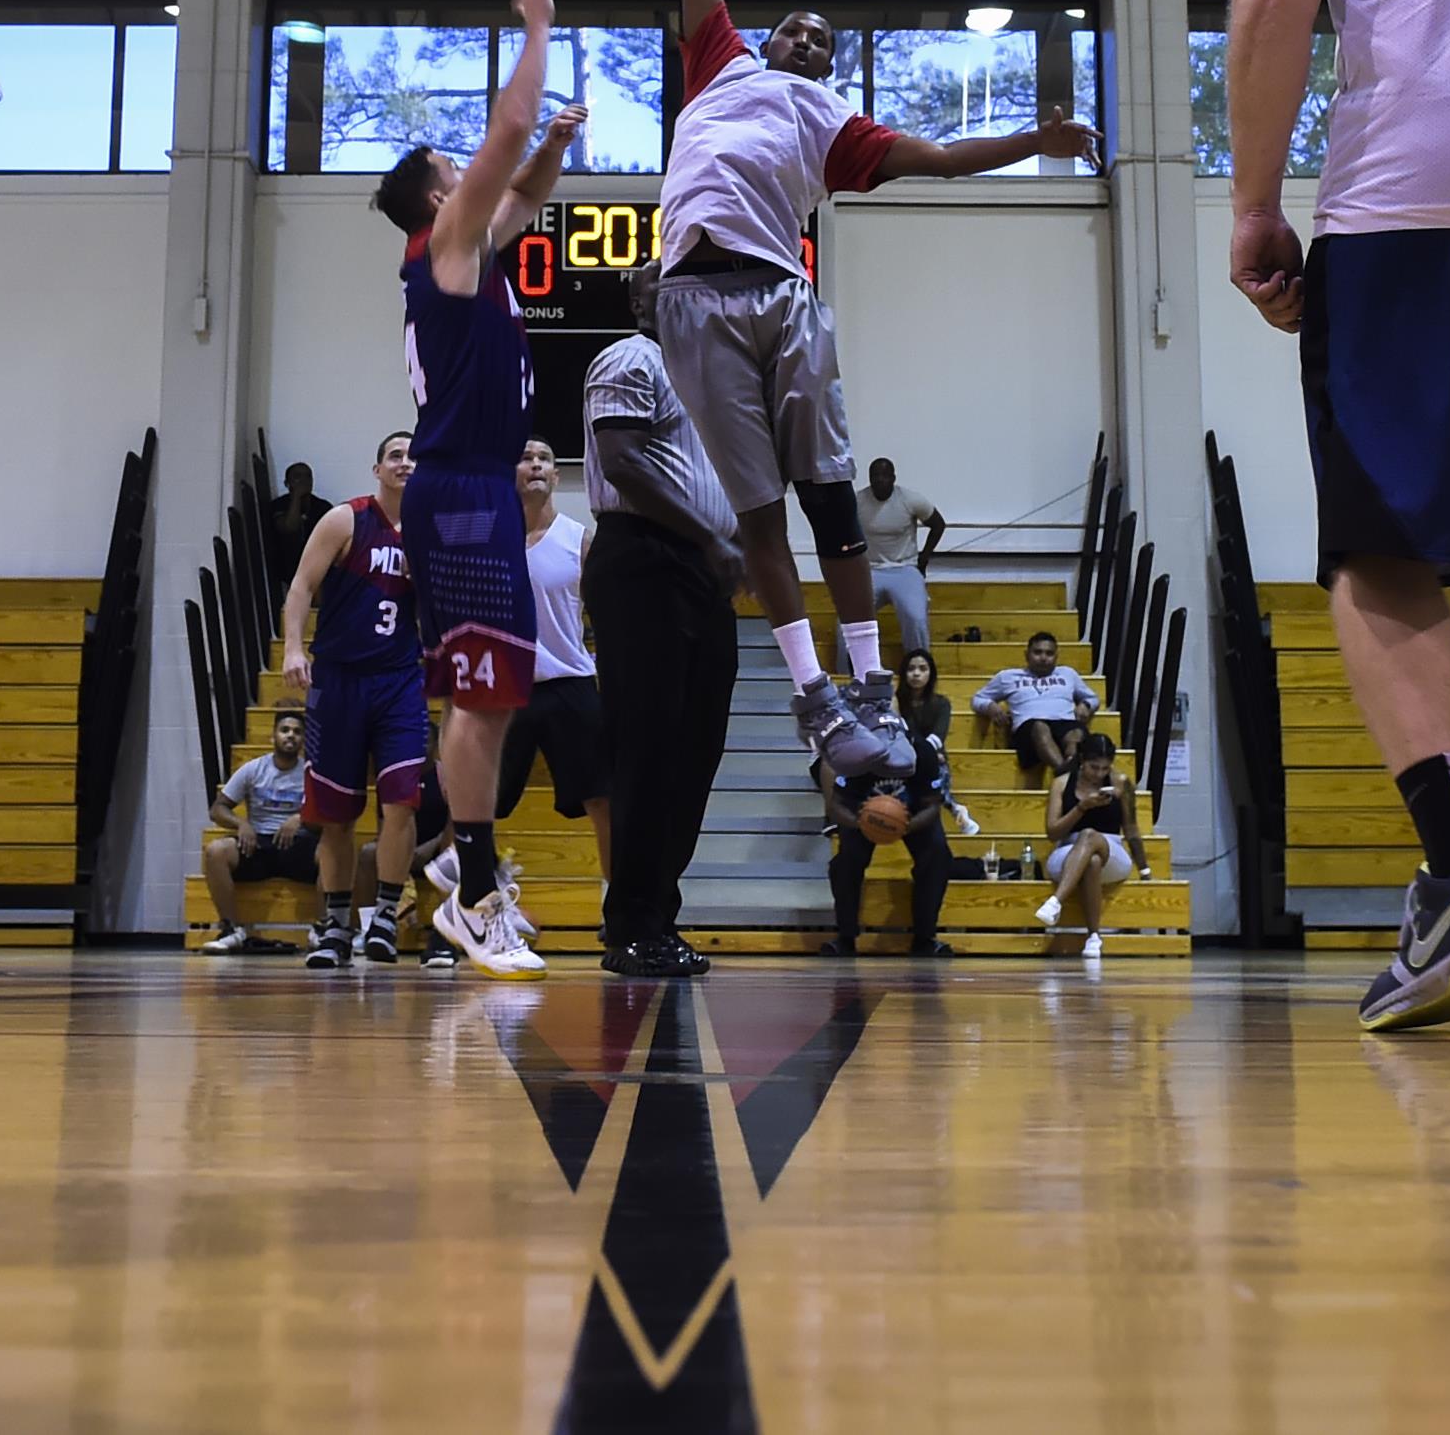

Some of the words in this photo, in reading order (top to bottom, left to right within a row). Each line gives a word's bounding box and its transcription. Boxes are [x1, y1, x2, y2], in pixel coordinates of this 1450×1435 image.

[519, 237, 553, 295] 0
[573, 280, 583, 292] 3
[374, 600, 399, 637] 3
[451, 649, 496, 691] 24
